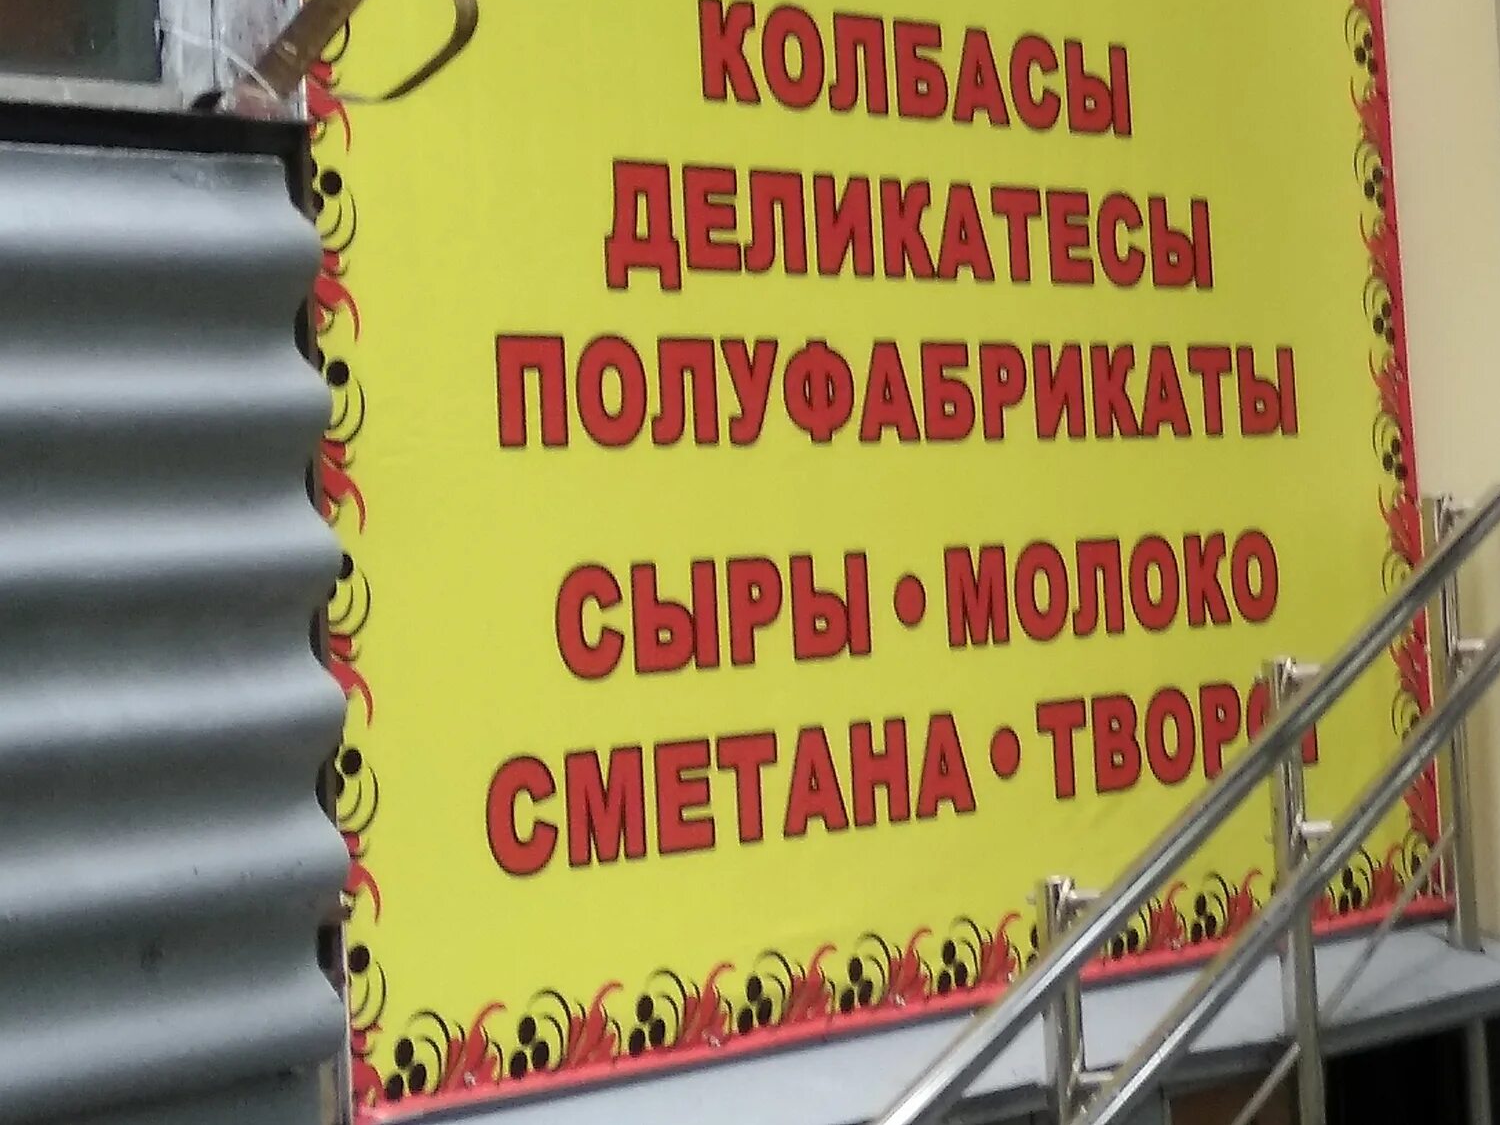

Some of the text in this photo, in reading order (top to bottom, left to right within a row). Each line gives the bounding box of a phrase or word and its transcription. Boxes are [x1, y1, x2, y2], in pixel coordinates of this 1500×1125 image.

[604, 160, 1215, 291] ДЕЛИКАТЕСЫ
[494, 333, 1299, 448] ПОЛУФАБРИКАТЫ
[555, 528, 1281, 680] СЫРЫ МОЛОКО
[485, 676, 1319, 876] СМЕТАНА ТВОР
